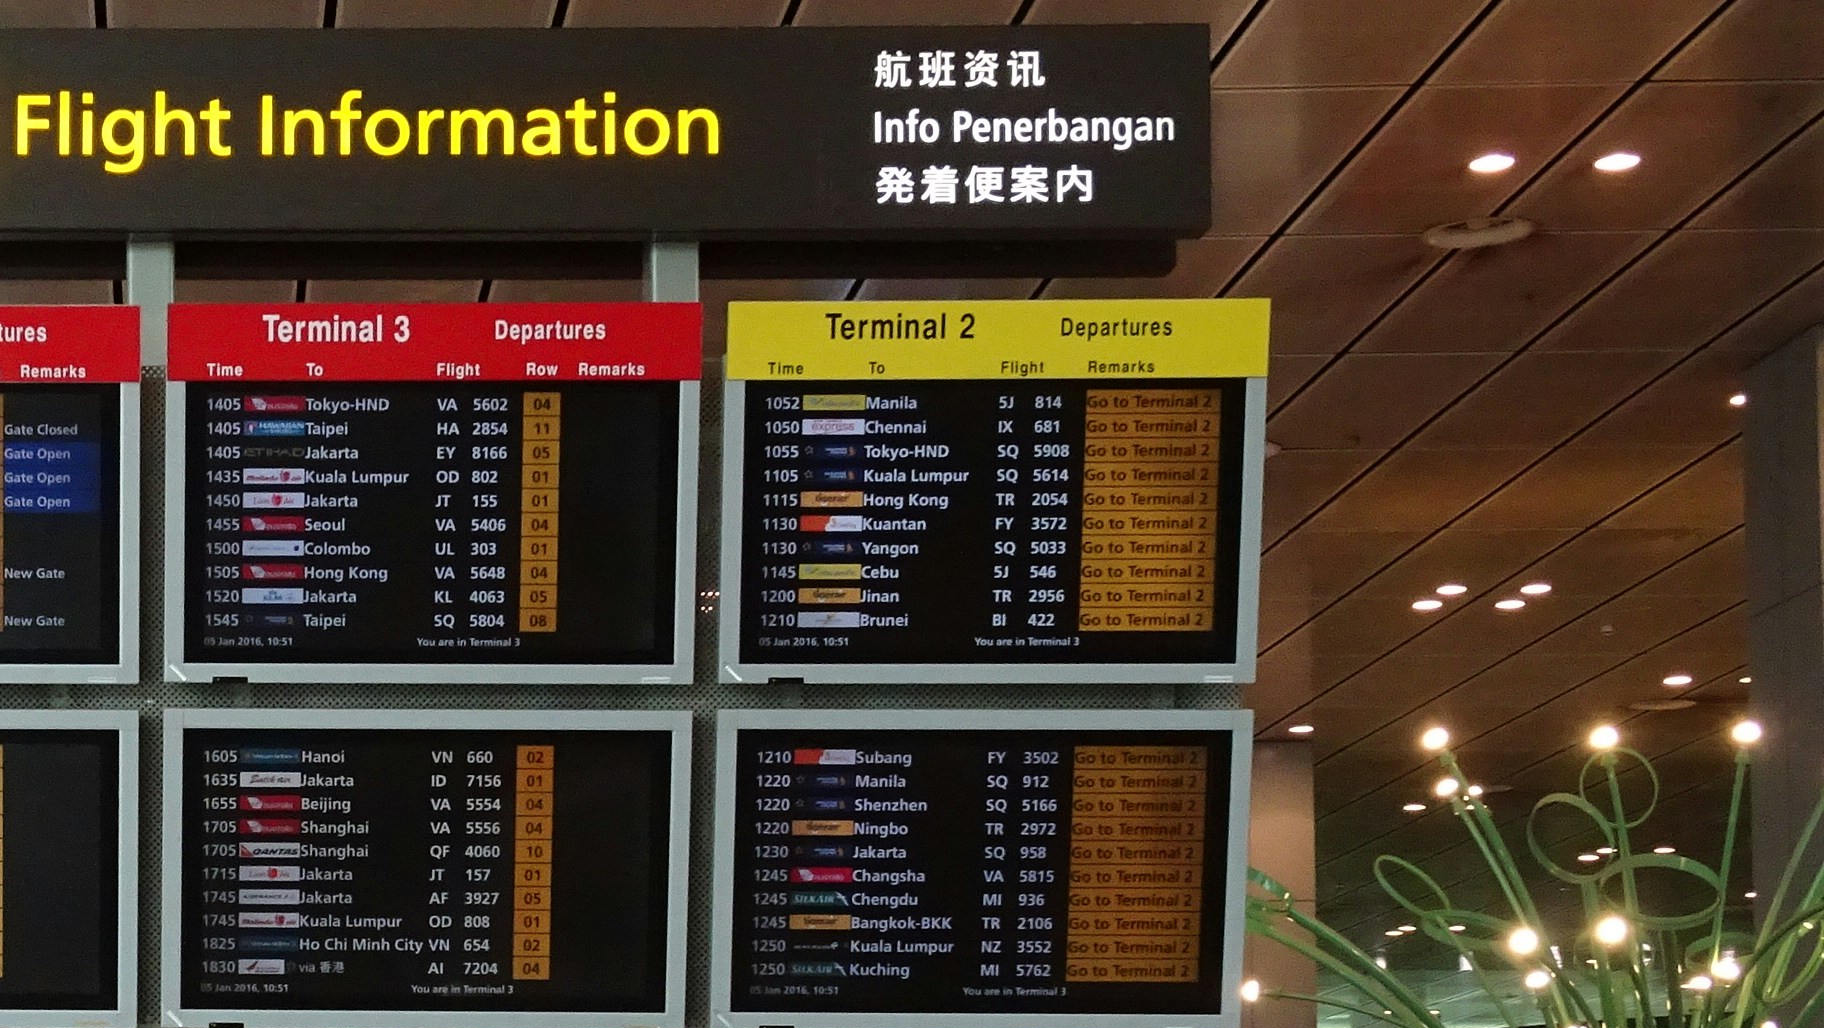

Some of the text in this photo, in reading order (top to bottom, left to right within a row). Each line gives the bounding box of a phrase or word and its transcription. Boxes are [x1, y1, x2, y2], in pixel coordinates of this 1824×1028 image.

[875, 50, 1045, 87] 航班资讯
[17, 91, 719, 173] Flight Information
[875, 108, 1174, 149] Info Penerbangan
[876, 165, 1092, 203] 発着便案内
[263, 315, 409, 342] Terminal 3
[495, 320, 606, 343] Departures
[826, 313, 975, 339] Terminal 2
[1061, 318, 1172, 339] Departures
[21, 365, 85, 378] Remarks
[207, 362, 644, 379] Time To Flight Row Remarks
[768, 361, 1154, 377] Time To Flight Remarks
[209, 398, 550, 413] 1405 Tokyo-HND VA 5602 04
[5, 425, 33, 435] Gate
[37, 424, 77, 435] Closed
[766, 420, 1059, 433] 1050 Chennai IX 681
[304, 542, 370, 555] Colombo
[863, 542, 918, 557] Yangon
[205, 750, 543, 764] 1605 Hanoi VN 660 02
[758, 751, 1058, 767] 1210 Subang FY 3502
[852, 870, 925, 884] Changsha
